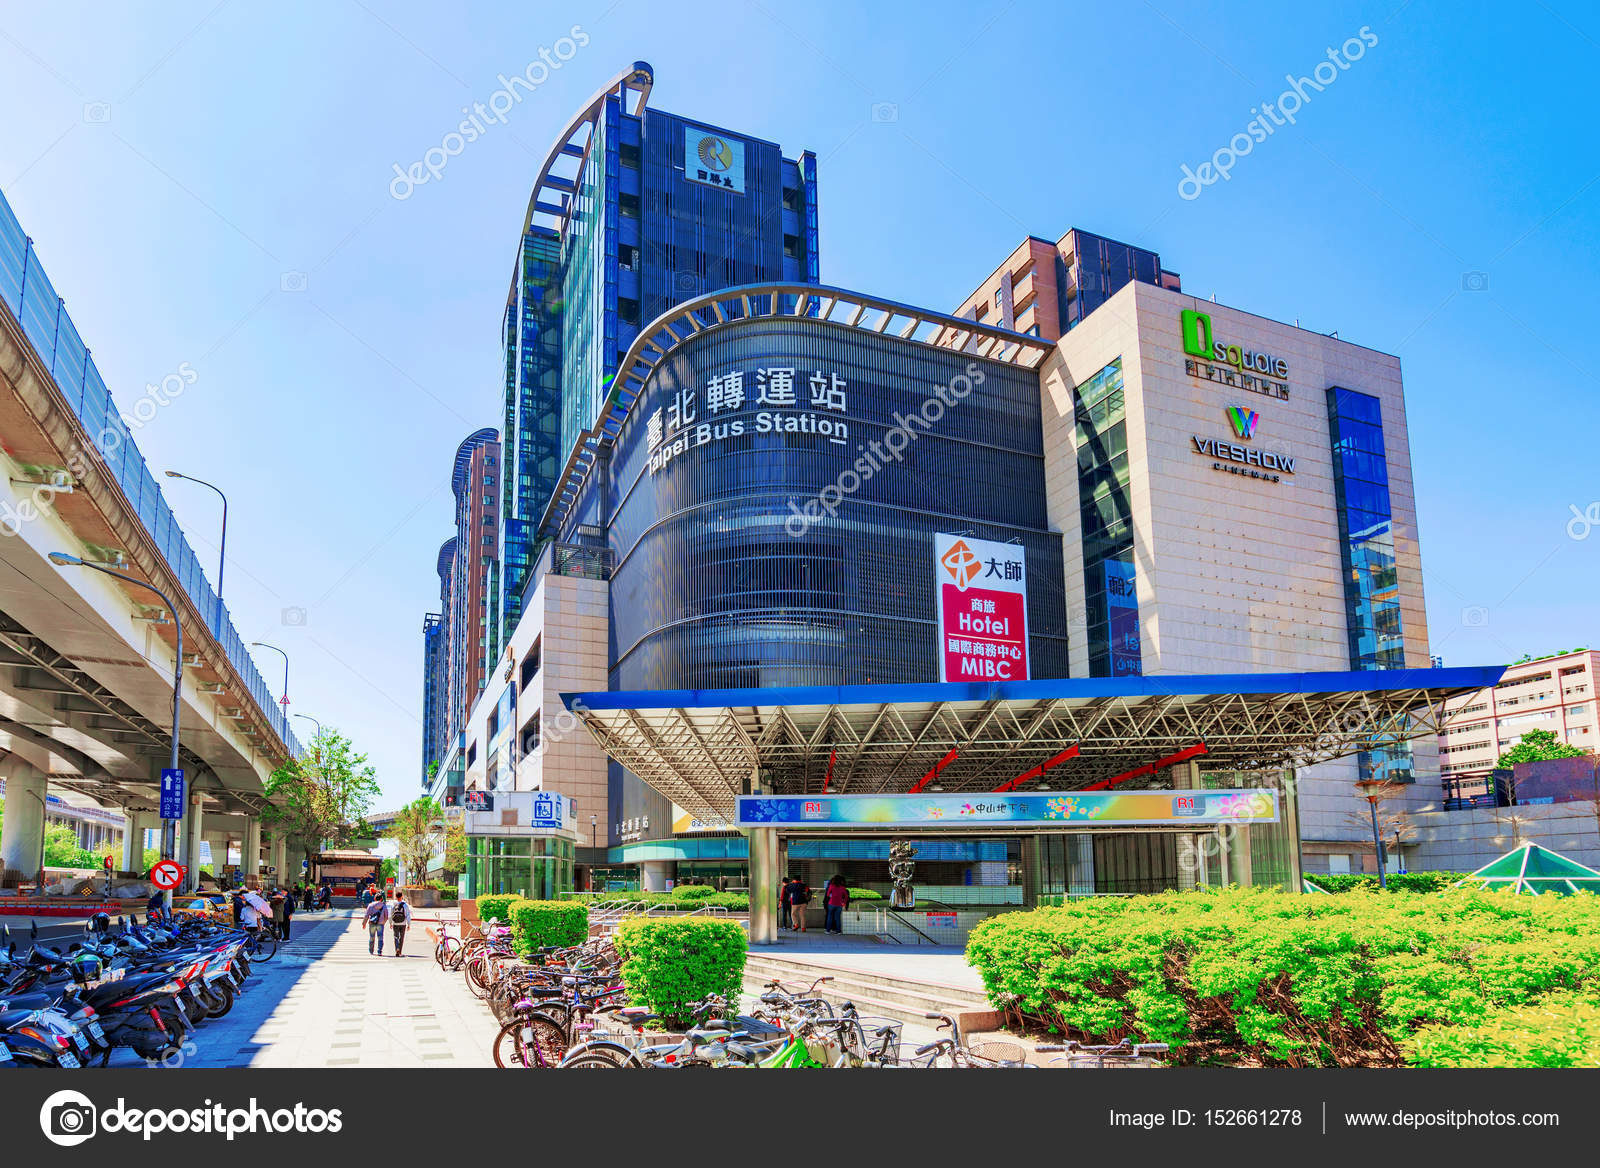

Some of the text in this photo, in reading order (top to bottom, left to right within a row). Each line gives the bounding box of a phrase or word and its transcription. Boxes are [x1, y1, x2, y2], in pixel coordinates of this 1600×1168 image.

[646, 366, 848, 454] 臺北轉運站
[647, 411, 848, 477] Taipei Bus Station
[1192, 433, 1296, 474] VIESHOW
[1213, 462, 1281, 484] CINEMAS
[984, 557, 1023, 582] 大師
[970, 598, 996, 614] 商旅
[959, 612, 1009, 636] Hotel
[948, 638, 1022, 660] 國際商務中心
[961, 657, 1012, 679] MIBC
[805, 801, 821, 813] R1
[1177, 797, 1194, 809] R1
